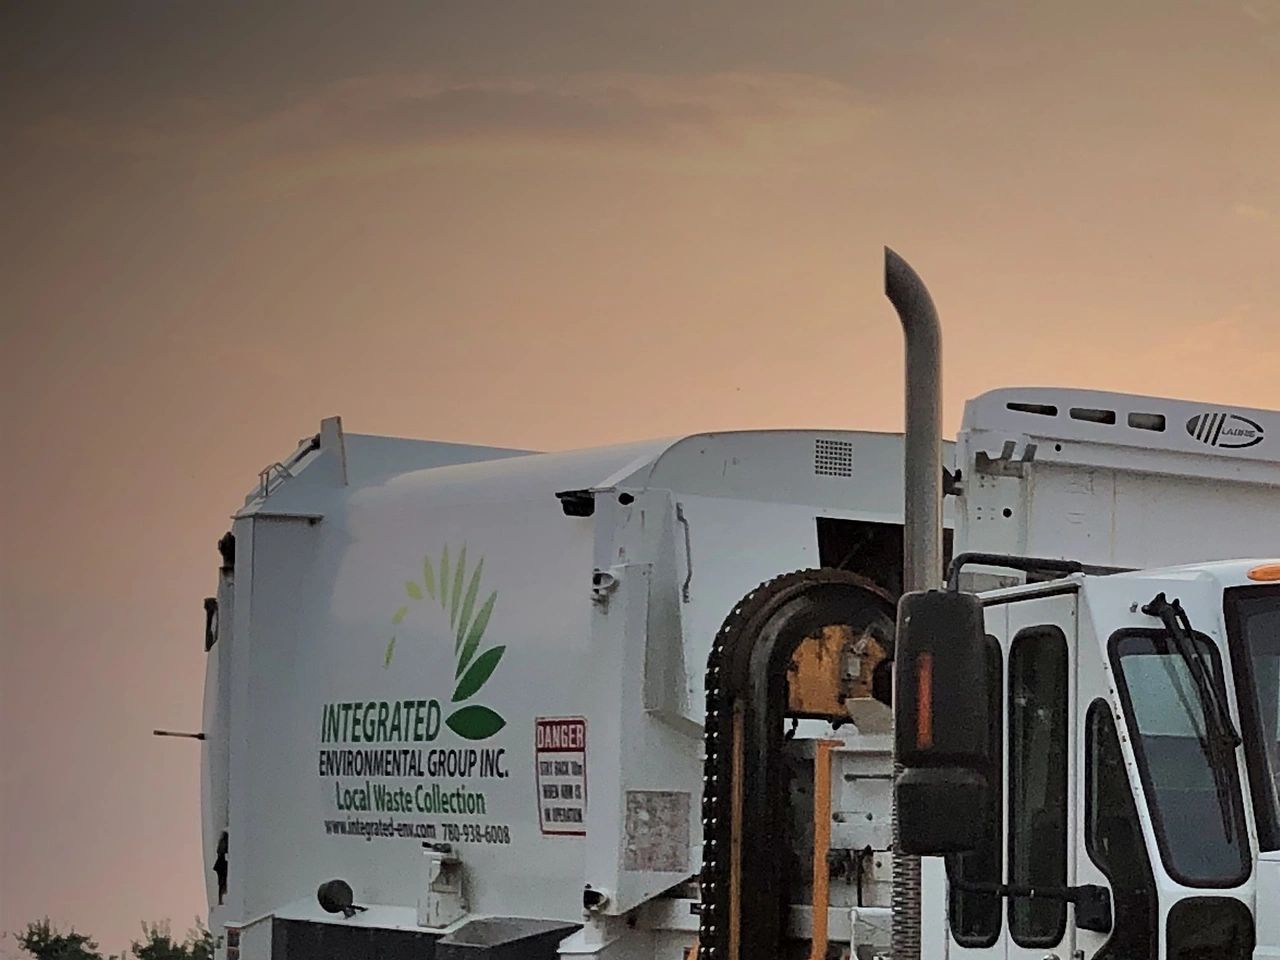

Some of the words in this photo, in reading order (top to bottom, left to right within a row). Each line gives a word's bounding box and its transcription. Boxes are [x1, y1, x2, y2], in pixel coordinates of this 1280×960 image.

[321, 699, 441, 743] INTEGRATED
[537, 724, 584, 748] DANGER
[319, 749, 425, 777] ENVIRONMENTAL
[427, 749, 478, 778] GROUP
[480, 748, 509, 778] INC.
[336, 781, 370, 812] Local
[373, 784, 412, 813] Waste
[415, 784, 486, 814] Collection
[324, 818, 437, 841] www.integrated-env.com
